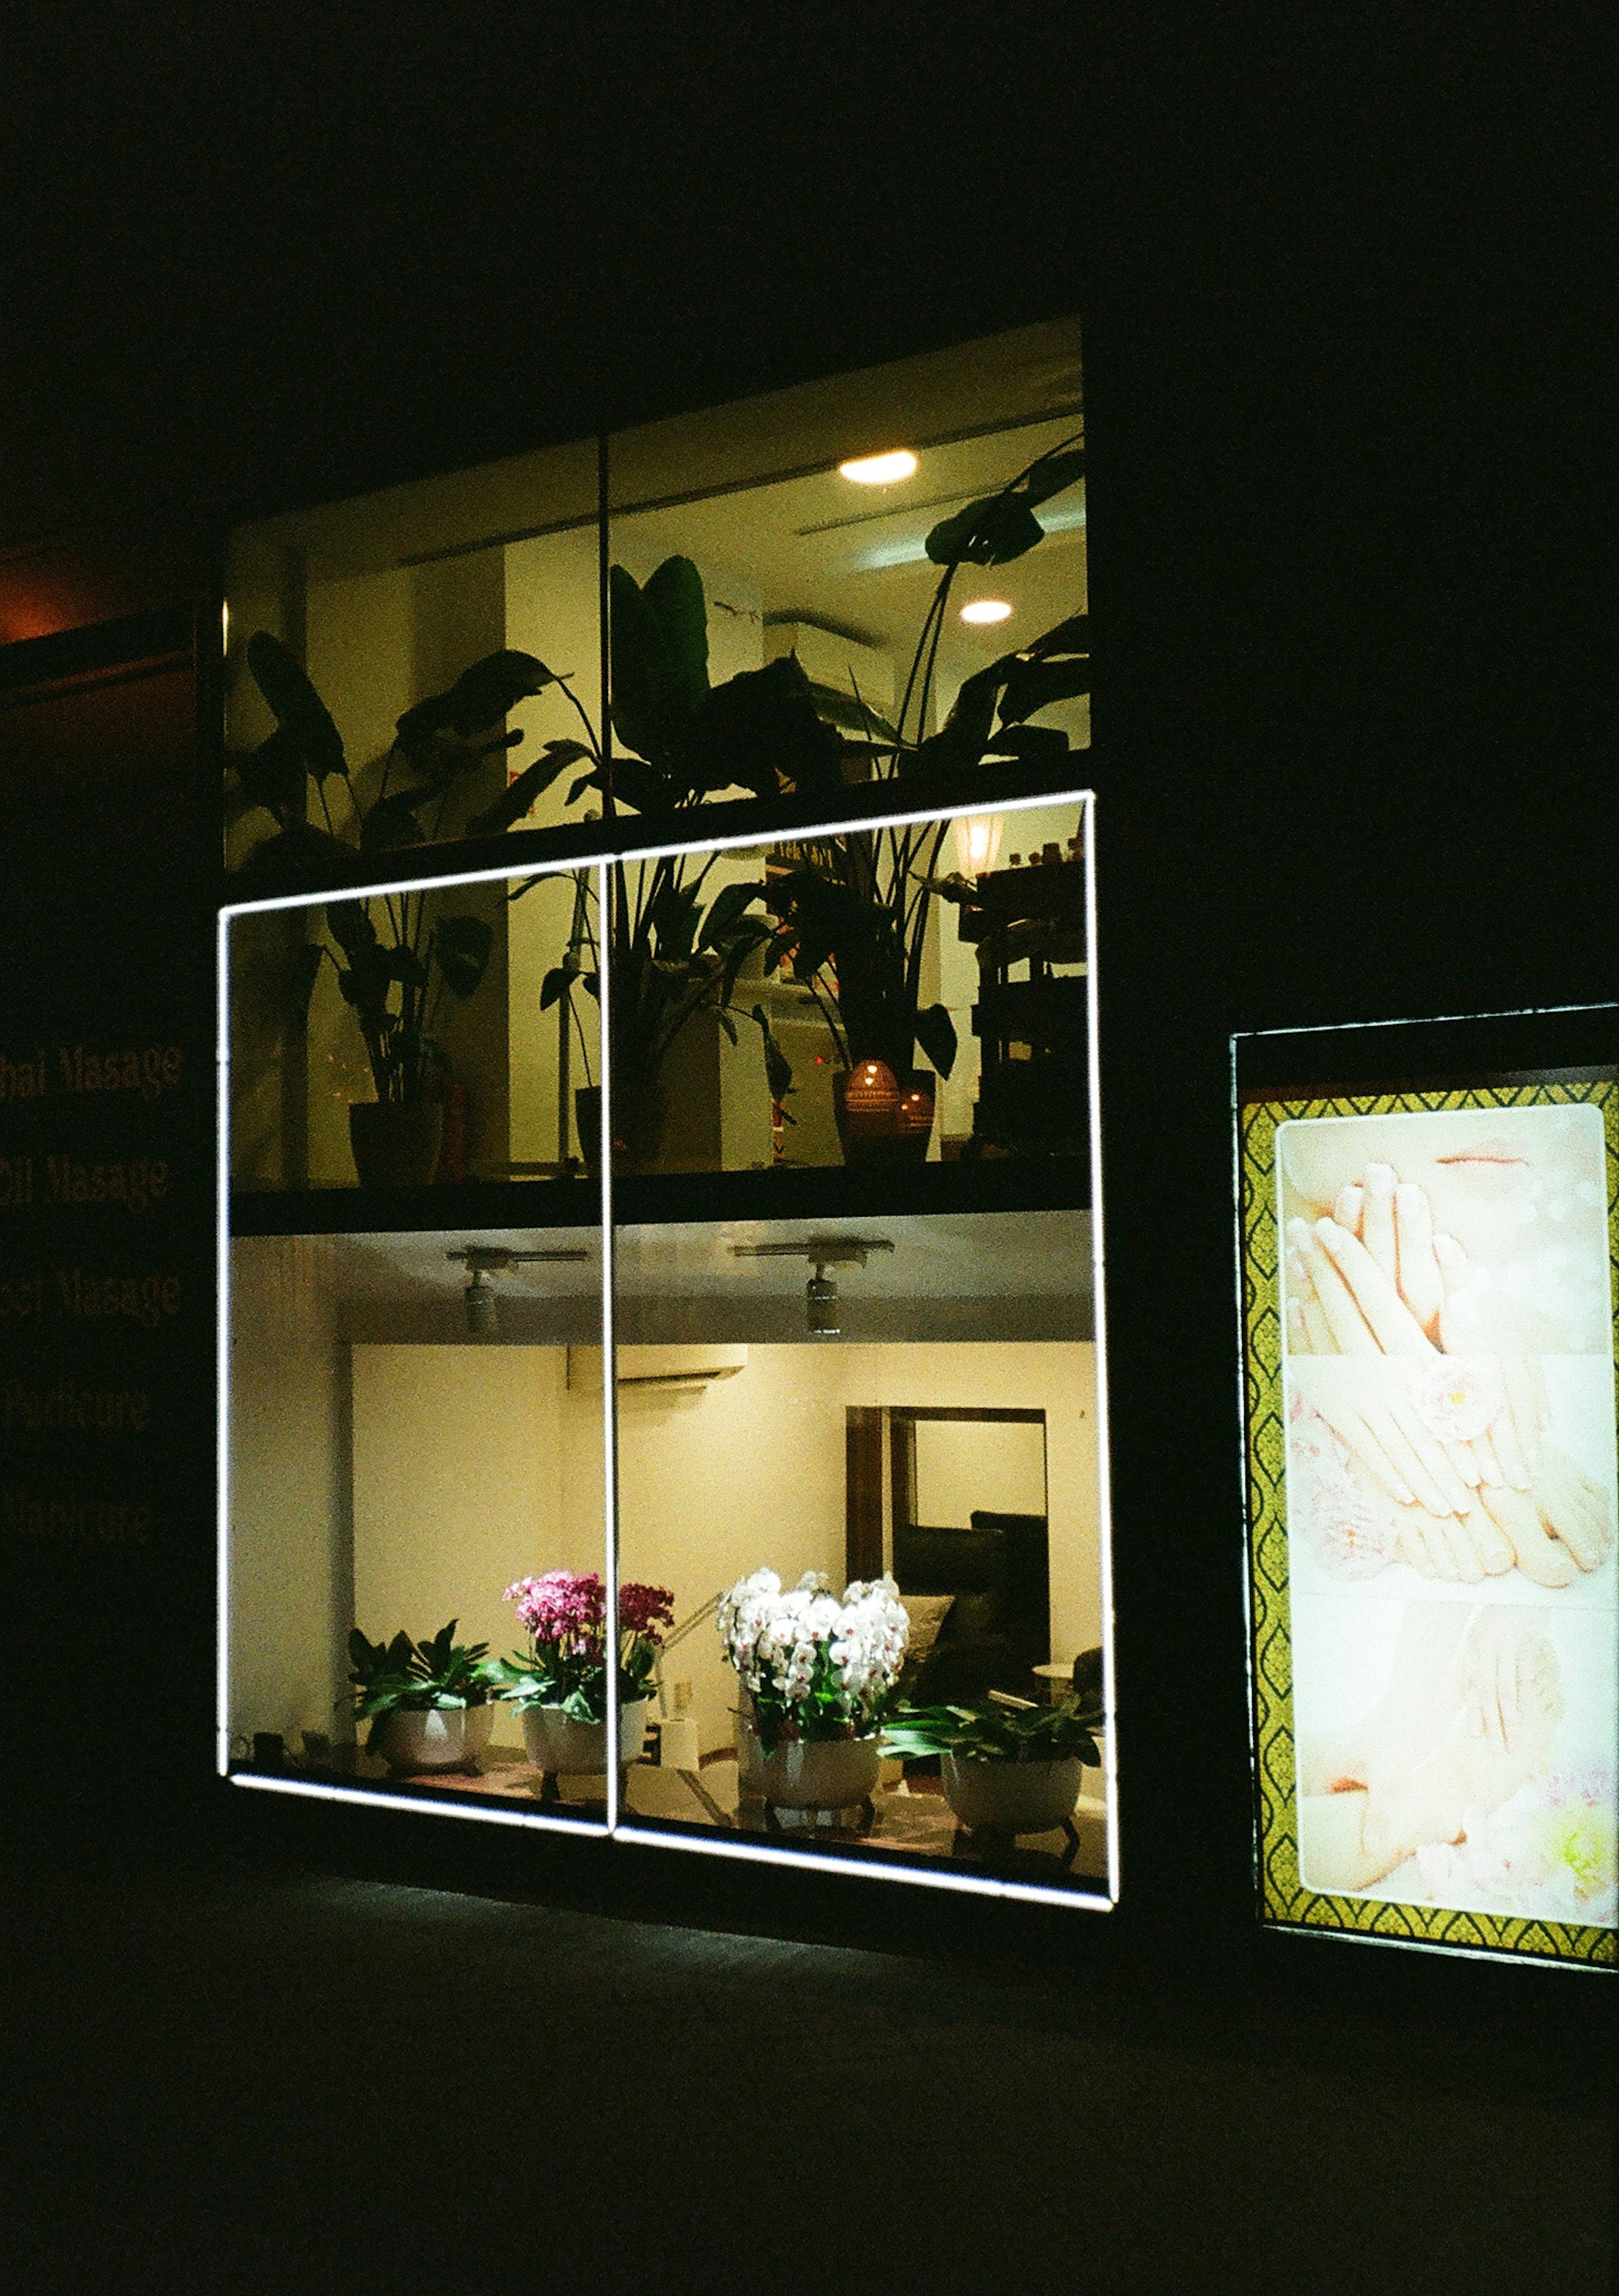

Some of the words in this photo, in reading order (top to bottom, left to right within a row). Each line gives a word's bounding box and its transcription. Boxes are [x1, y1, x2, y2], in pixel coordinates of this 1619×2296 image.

[58, 1045, 184, 1100] Masage
[46, 1155, 169, 1213] Masage
[56, 1268, 181, 1328] Masage
[2, 1378, 150, 1430] Pedicure
[2, 1489, 152, 1545] Manicure
